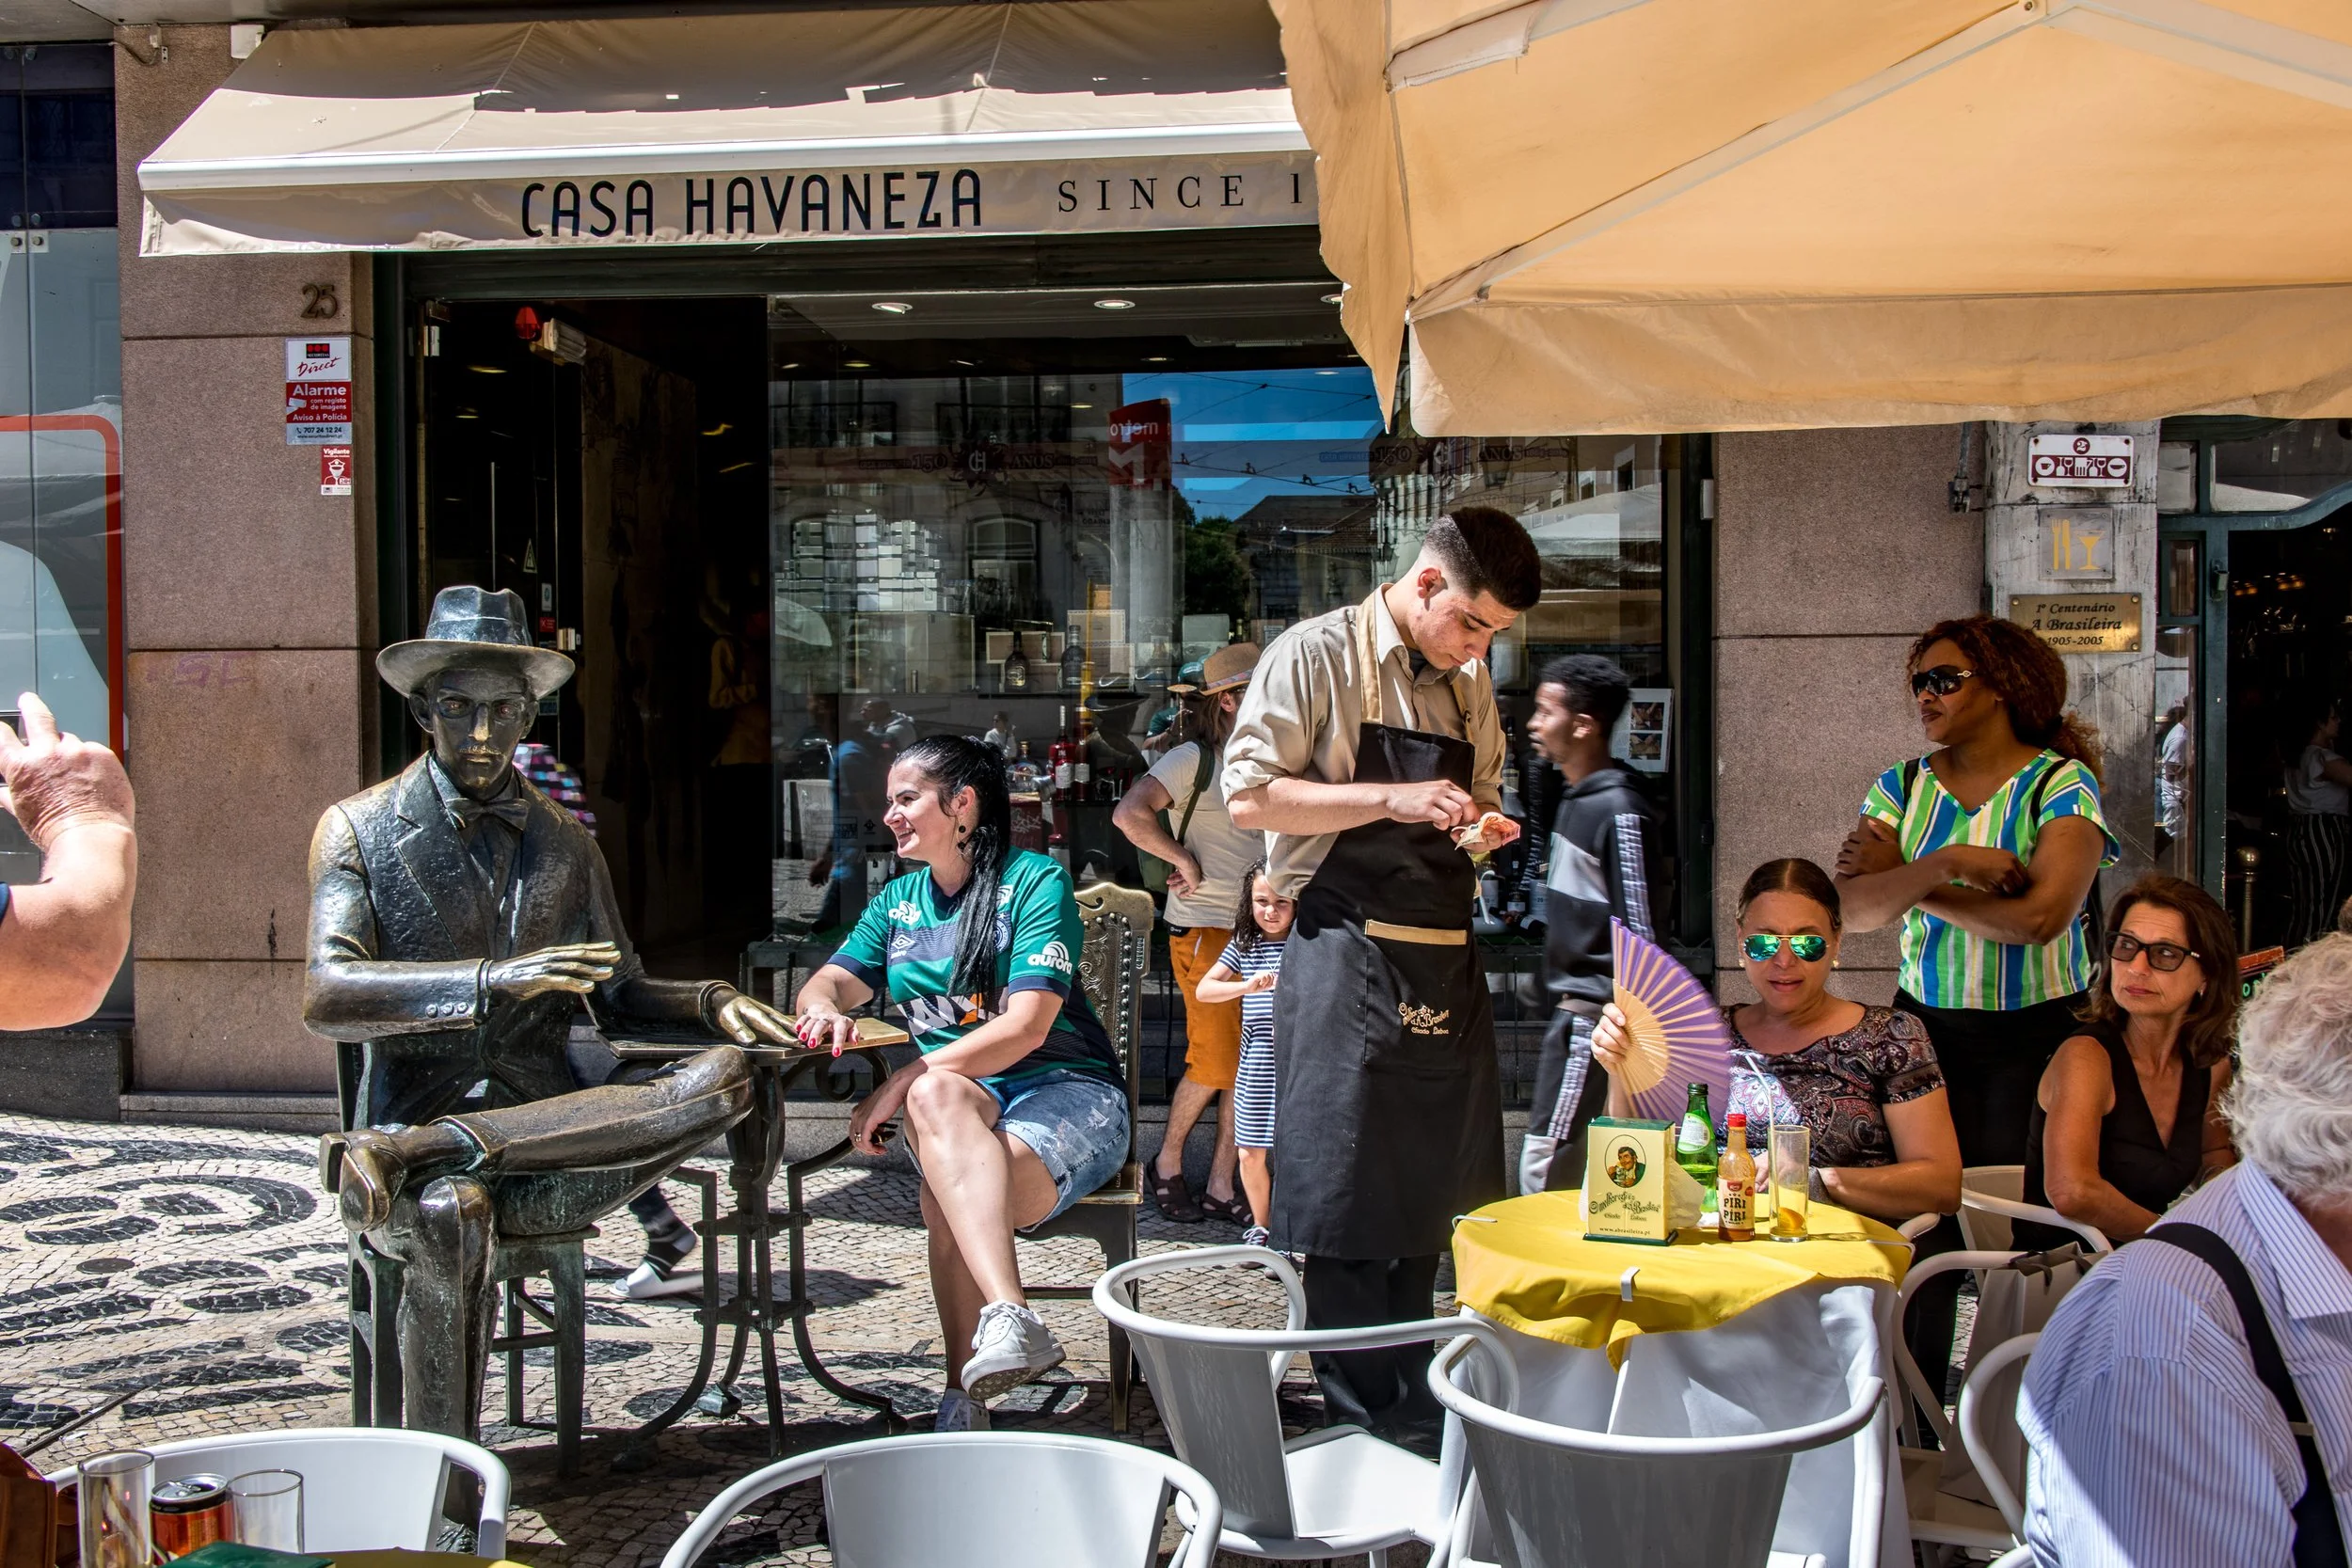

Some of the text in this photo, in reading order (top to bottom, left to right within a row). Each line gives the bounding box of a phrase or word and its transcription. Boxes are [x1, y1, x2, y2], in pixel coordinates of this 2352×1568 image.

[521, 180, 654, 238] CASA
[685, 169, 981, 235] HAVANEZA
[1057, 175, 1244, 213] SINCE
[300, 283, 338, 319] 25
[296, 356, 342, 377] Direct
[293, 384, 347, 396] Alarme
[2050, 602, 2116, 613] Centenário
[2032, 617, 2122, 630] A Brasileira
[2047, 636, 2104, 645] 1905-2005
[1027, 954, 1073, 974] aurora
[1724, 1197, 1746, 1210] PIRI
[1599, 1227, 1650, 1236] www.abrasileira.pt
